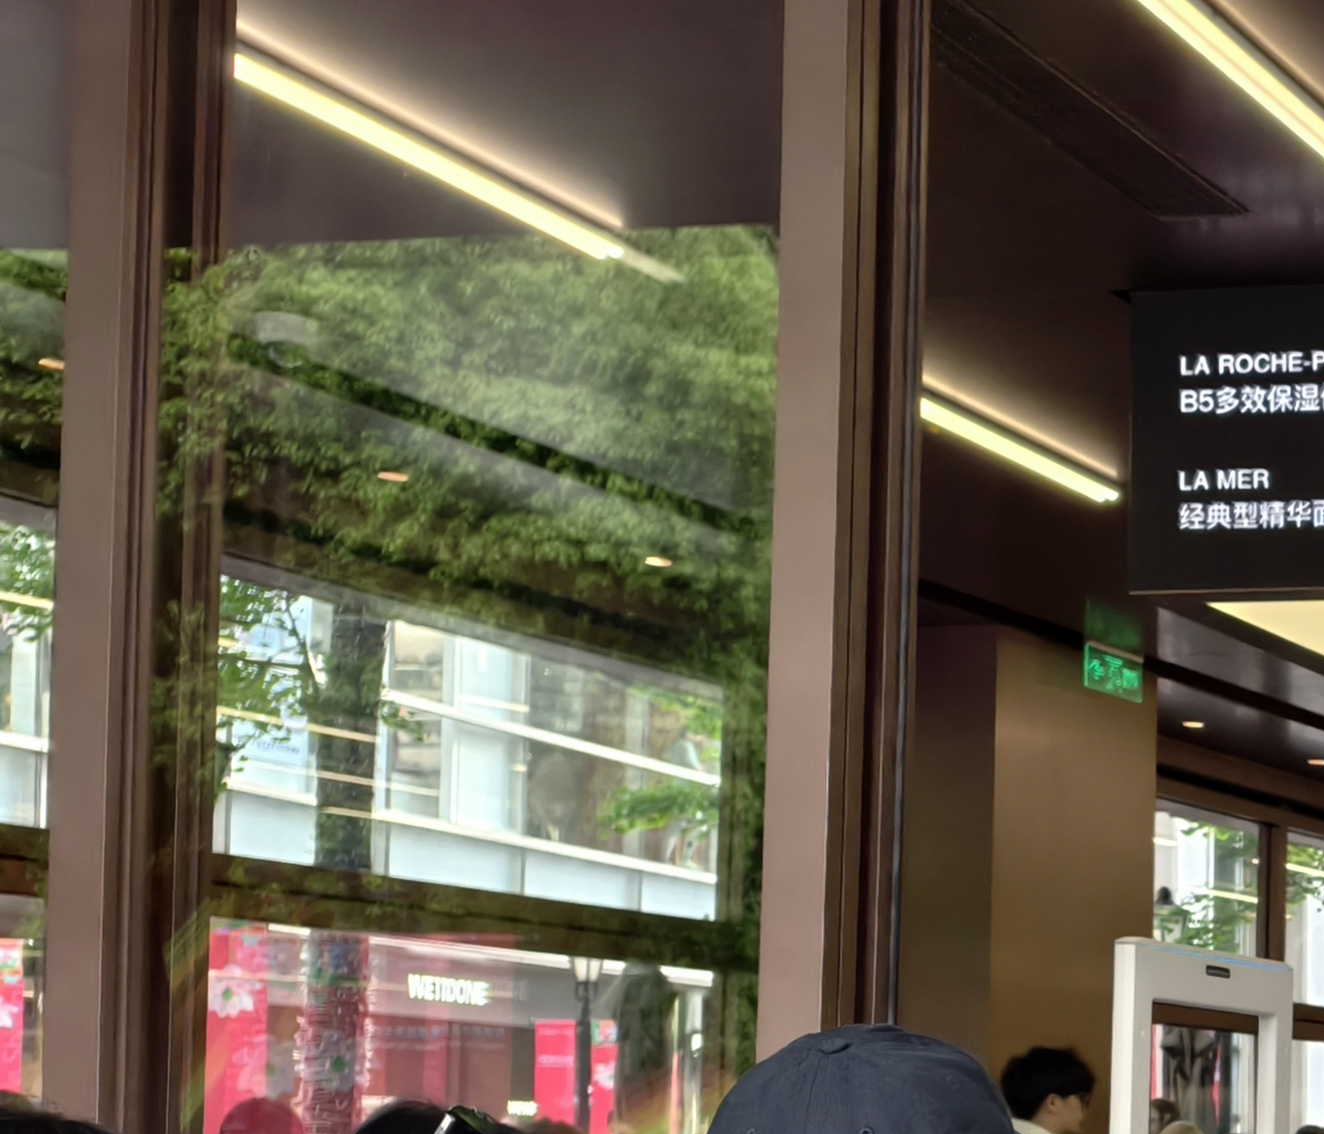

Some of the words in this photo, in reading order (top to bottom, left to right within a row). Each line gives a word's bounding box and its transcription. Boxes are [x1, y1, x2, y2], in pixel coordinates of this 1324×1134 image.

[1179, 354, 1211, 376] LA
[1178, 469, 1210, 492] LA
[1216, 468, 1270, 490] MER
